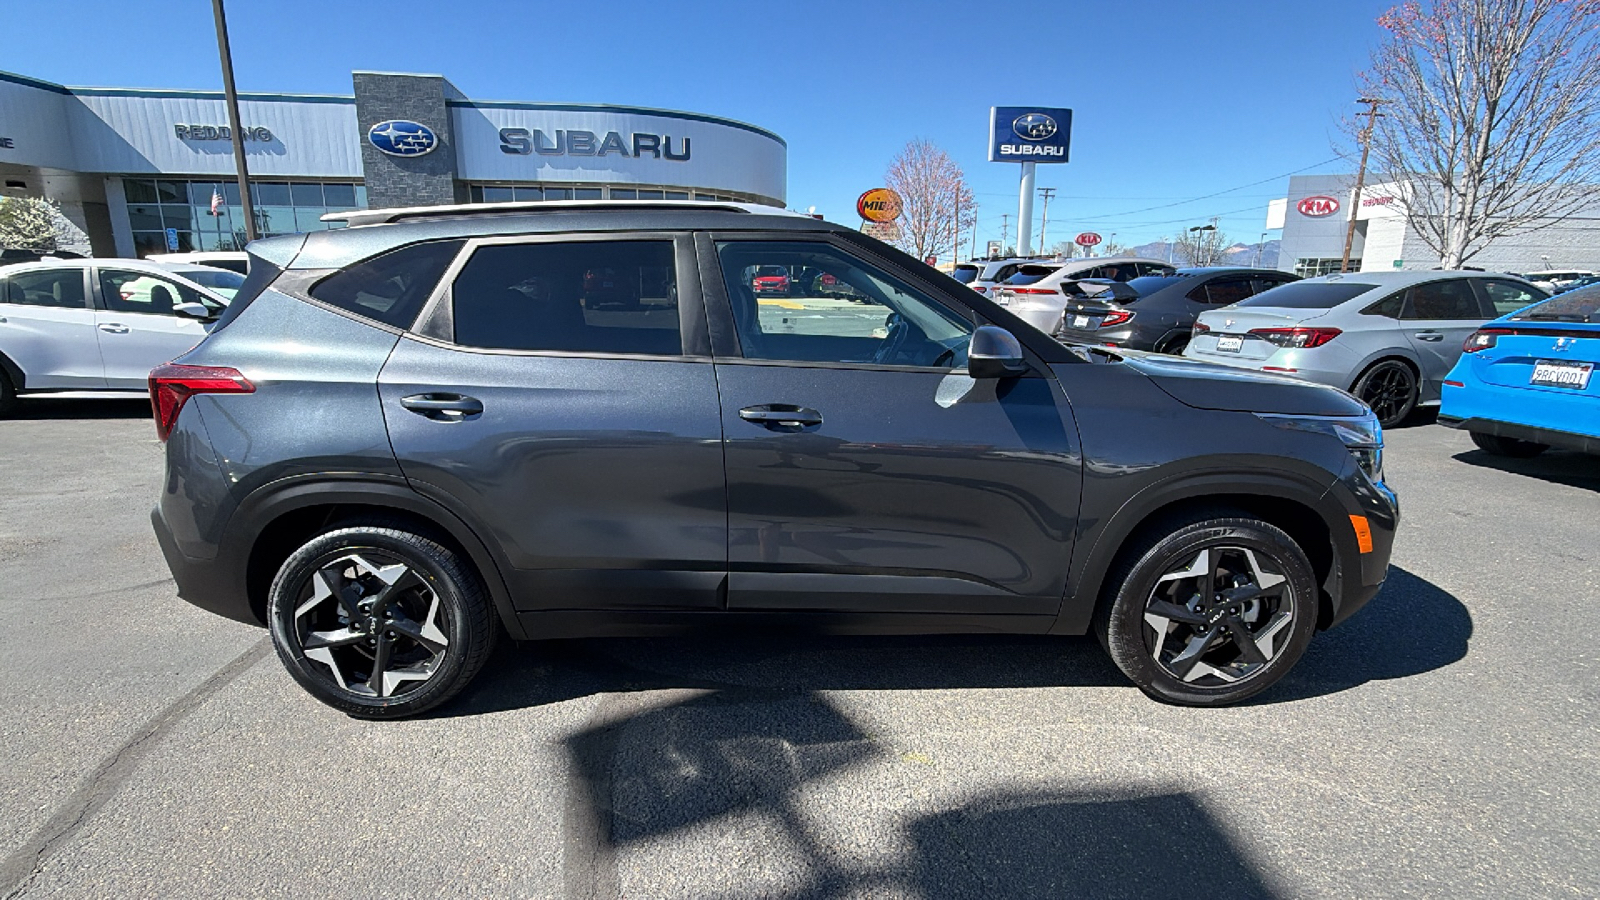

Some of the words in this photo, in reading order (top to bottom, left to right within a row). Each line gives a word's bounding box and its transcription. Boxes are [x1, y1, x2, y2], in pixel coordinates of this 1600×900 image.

[174, 124, 271, 142] REDDNG
[499, 128, 691, 161] SUBARU
[1000, 144, 1064, 156] SUBARU
[1304, 200, 1333, 213] KIA
[1081, 234, 1098, 244] KIA
